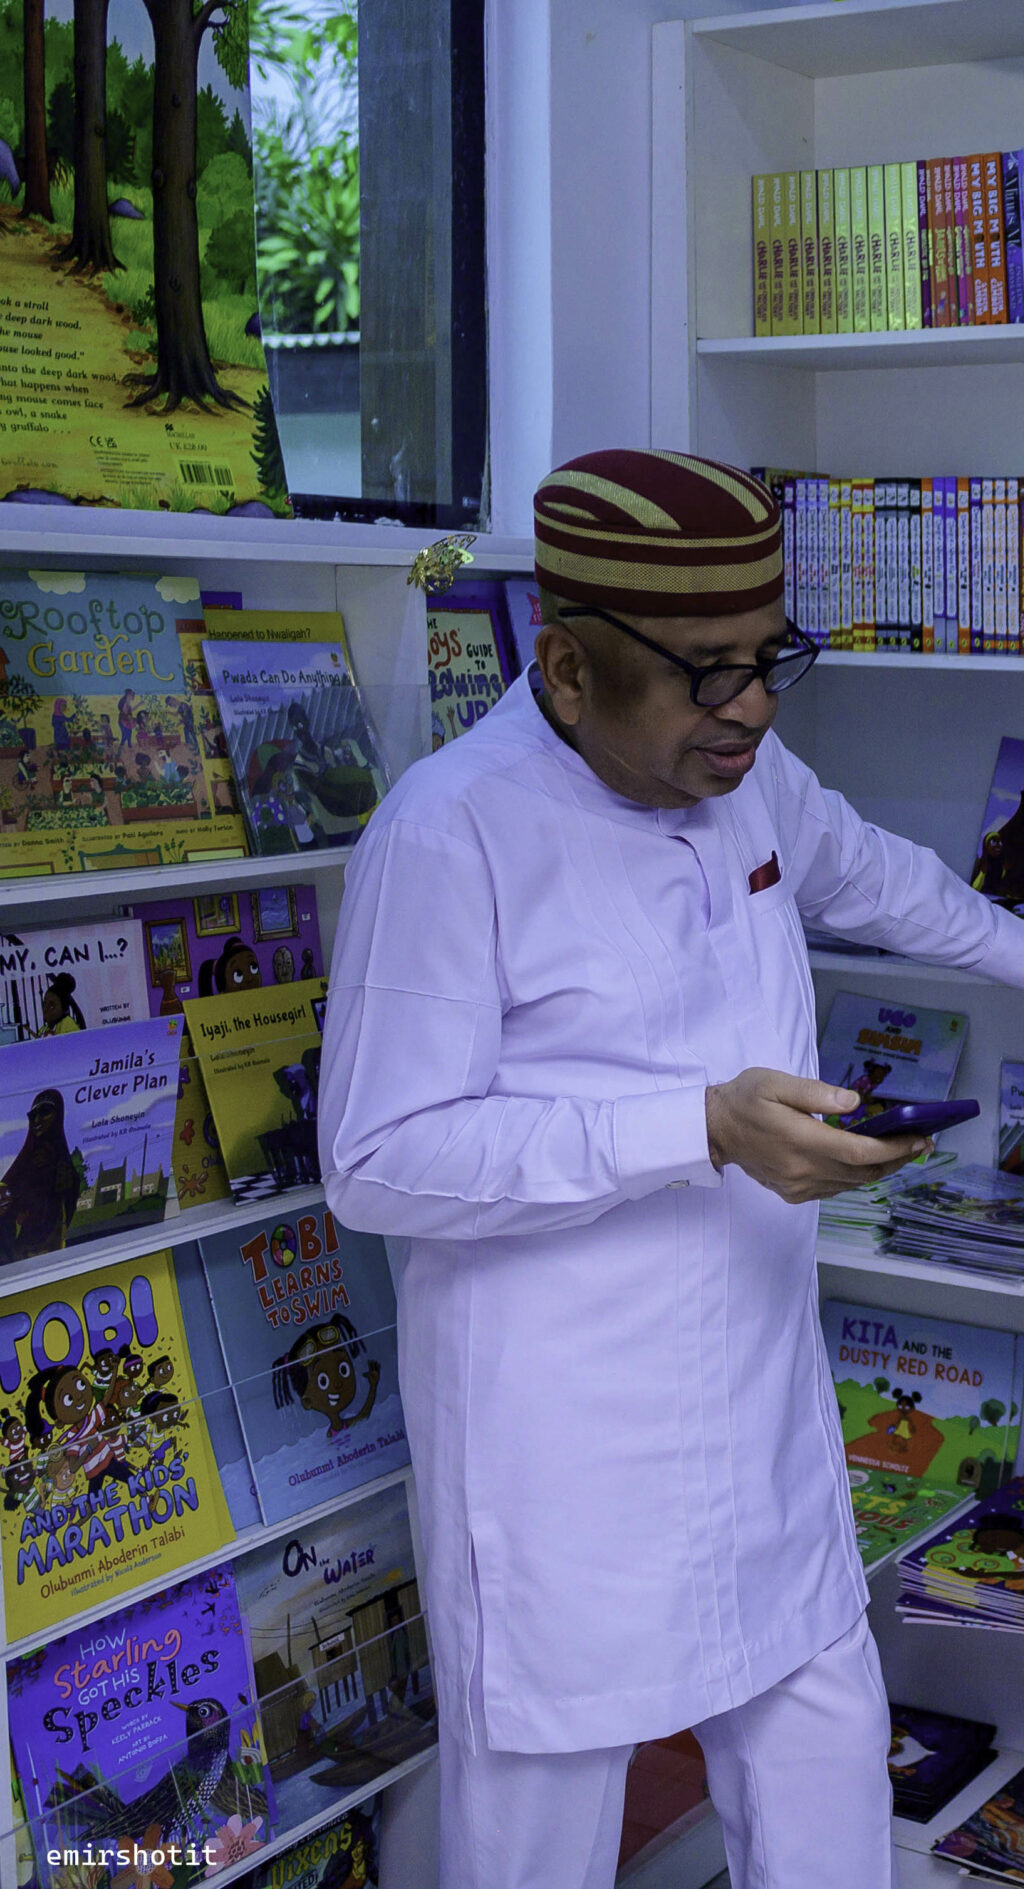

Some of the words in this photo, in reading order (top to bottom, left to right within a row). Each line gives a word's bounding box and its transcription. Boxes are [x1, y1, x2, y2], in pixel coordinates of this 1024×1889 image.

[971, 163, 981, 188] MY
[986, 161, 997, 186] MY
[973, 191, 983, 216] BIG
[988, 190, 999, 215] BIG
[24, 300, 49, 311] stroll
[5, 312, 27, 324] deep
[30, 314, 52, 326] dark
[56, 321, 81, 330] wood.
[14, 330, 43, 339] mouse
[22, 345, 52, 357] looked
[22, 365, 36, 374] the
[41, 366, 62, 379] deep
[66, 369, 87, 379] dark
[21, 379, 60, 392] happens
[65, 384, 88, 394] when
[30, 410, 36, 418] a
[40, 411, 67, 420] snake
[52, 398, 81, 407] comes
[84, 399, 103, 408] face
[0, 599, 164, 642] Rooftop
[427, 618, 438, 629] HE
[256, 630, 265, 639] to
[27, 634, 174, 681] Garden
[466, 643, 494, 658] GUIDE
[475, 660, 486, 670] TO
[222, 670, 258, 684] Pwada
[260, 670, 280, 684] Can
[281, 670, 296, 683] Do
[299, 670, 340, 686] Anything
[0, 948, 36, 976] MY,
[44, 943, 90, 967] CAN
[233, 1016, 251, 1032] the
[253, 1005, 306, 1027] Housegirl
[89, 1049, 155, 1076] Jamila's
[75, 1083, 128, 1104] Clever
[133, 1073, 167, 1092] Plan
[258, 1258, 343, 1310] LEARNS
[266, 1306, 290, 1328] TO
[291, 1283, 351, 1325] SWIM
[842, 1318, 898, 1349] KITA
[902, 1340, 927, 1355] AND
[932, 1345, 952, 1360] THE
[839, 1345, 891, 1370] DUSTY
[897, 1356, 928, 1376] RED
[934, 1363, 983, 1387] ROAD
[20, 1505, 68, 1544] AND
[72, 1483, 121, 1518] THE
[17, 1477, 199, 1585] MARATHON
[40, 1565, 95, 1599] Olubunmi
[98, 1542, 148, 1572] Aboderin
[152, 1525, 185, 1549] Talabi
[79, 1628, 126, 1660] HOW
[53, 1629, 182, 1699] Starling
[43, 1650, 221, 1753] Speckles
[78, 1680, 109, 1705] GOT
